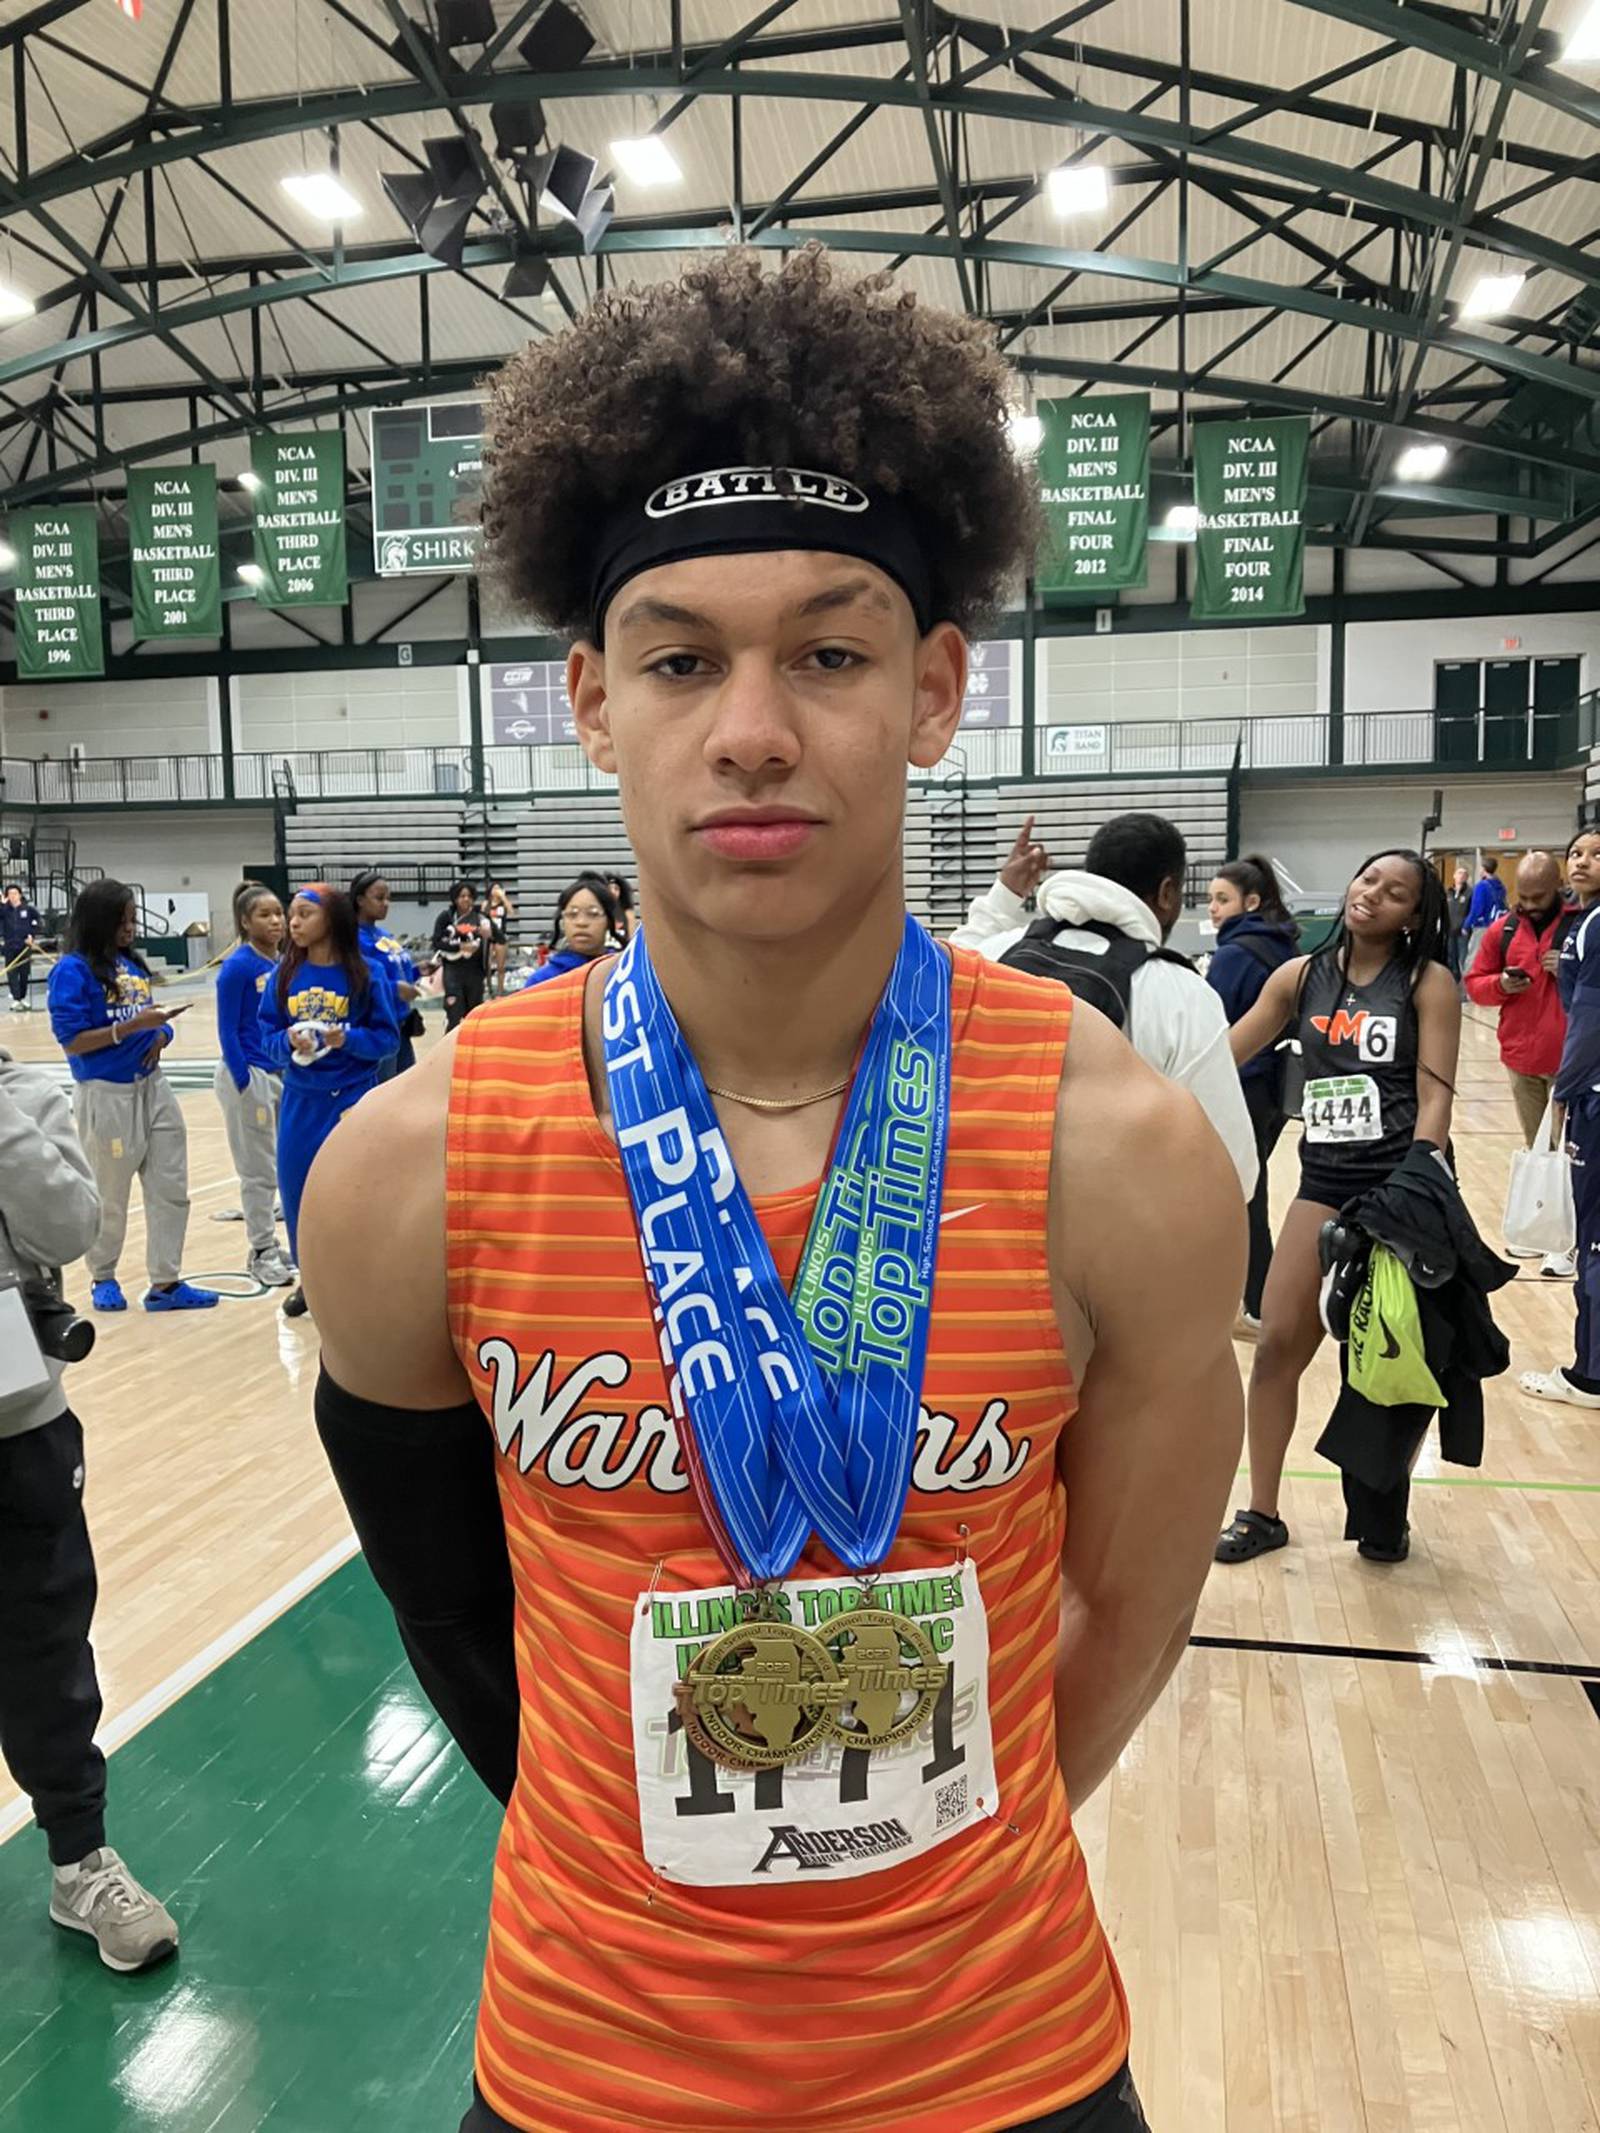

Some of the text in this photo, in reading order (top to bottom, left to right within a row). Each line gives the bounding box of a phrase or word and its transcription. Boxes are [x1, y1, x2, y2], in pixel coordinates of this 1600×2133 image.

[1071, 413, 1117, 429] NCAA
[277, 446, 316, 462] NCAA
[1067, 437, 1119, 454] DIV. III
[1228, 437, 1276, 454] NCAA
[275, 467, 318, 484] DIV. III
[1067, 461, 1118, 478] MEN'S
[1222, 462, 1278, 479] DIV. III
[154, 481, 191, 496] NCAA
[664, 472, 848, 507] BATTLE
[1040, 484, 1145, 503] BASKETBALL
[1224, 487, 1276, 504] MEN'S
[276, 489, 318, 506] MEN'S
[151, 502, 193, 518] DIV. III
[1067, 510, 1117, 527] FINAL
[256, 510, 342, 529] BASKETBALL
[1198, 510, 1302, 529] BASKETBALL
[34, 522, 70, 537] NCAA
[153, 524, 193, 539] MEN'S
[276, 534, 319, 550] THIRD
[411, 539, 476, 561] SHIRK
[1069, 534, 1114, 551] FOUR
[1223, 536, 1275, 554] FINAL
[32, 543, 73, 559] DIV. III
[132, 545, 215, 562] BASKETBALL
[35, 564, 74, 579] MEN'S
[278, 556, 321, 572] PLACE
[1074, 559, 1107, 575] 2012
[1225, 560, 1271, 578] FOUR
[152, 567, 194, 582] THIRD
[15, 585, 96, 602] BASKETBALL
[287, 578, 314, 593] 2006
[1231, 586, 1264, 602] 2014
[154, 589, 196, 604] PLACE
[35, 607, 75, 622] THIRD
[163, 610, 188, 625] 2001
[37, 628, 78, 643] PLACE
[47, 650, 71, 664] 1996
[399, 647, 410, 662] G
[1366, 1020, 1388, 1057] 6
[1309, 1095, 1374, 1127] 1444
[618, 1106, 736, 1398] PLACE
[798, 1231, 830, 1313] ILLINOIS
[855, 1230, 875, 1315] ILLINOIS
[846, 1697, 932, 1746] CHAMPIONSHIP
[688, 1721, 726, 1760] INDOOR
[704, 1710, 743, 1752] INDOOR
[746, 1713, 833, 1759] CHAMPIONSHIP
[752, 1818, 909, 1874] ANDERSON
